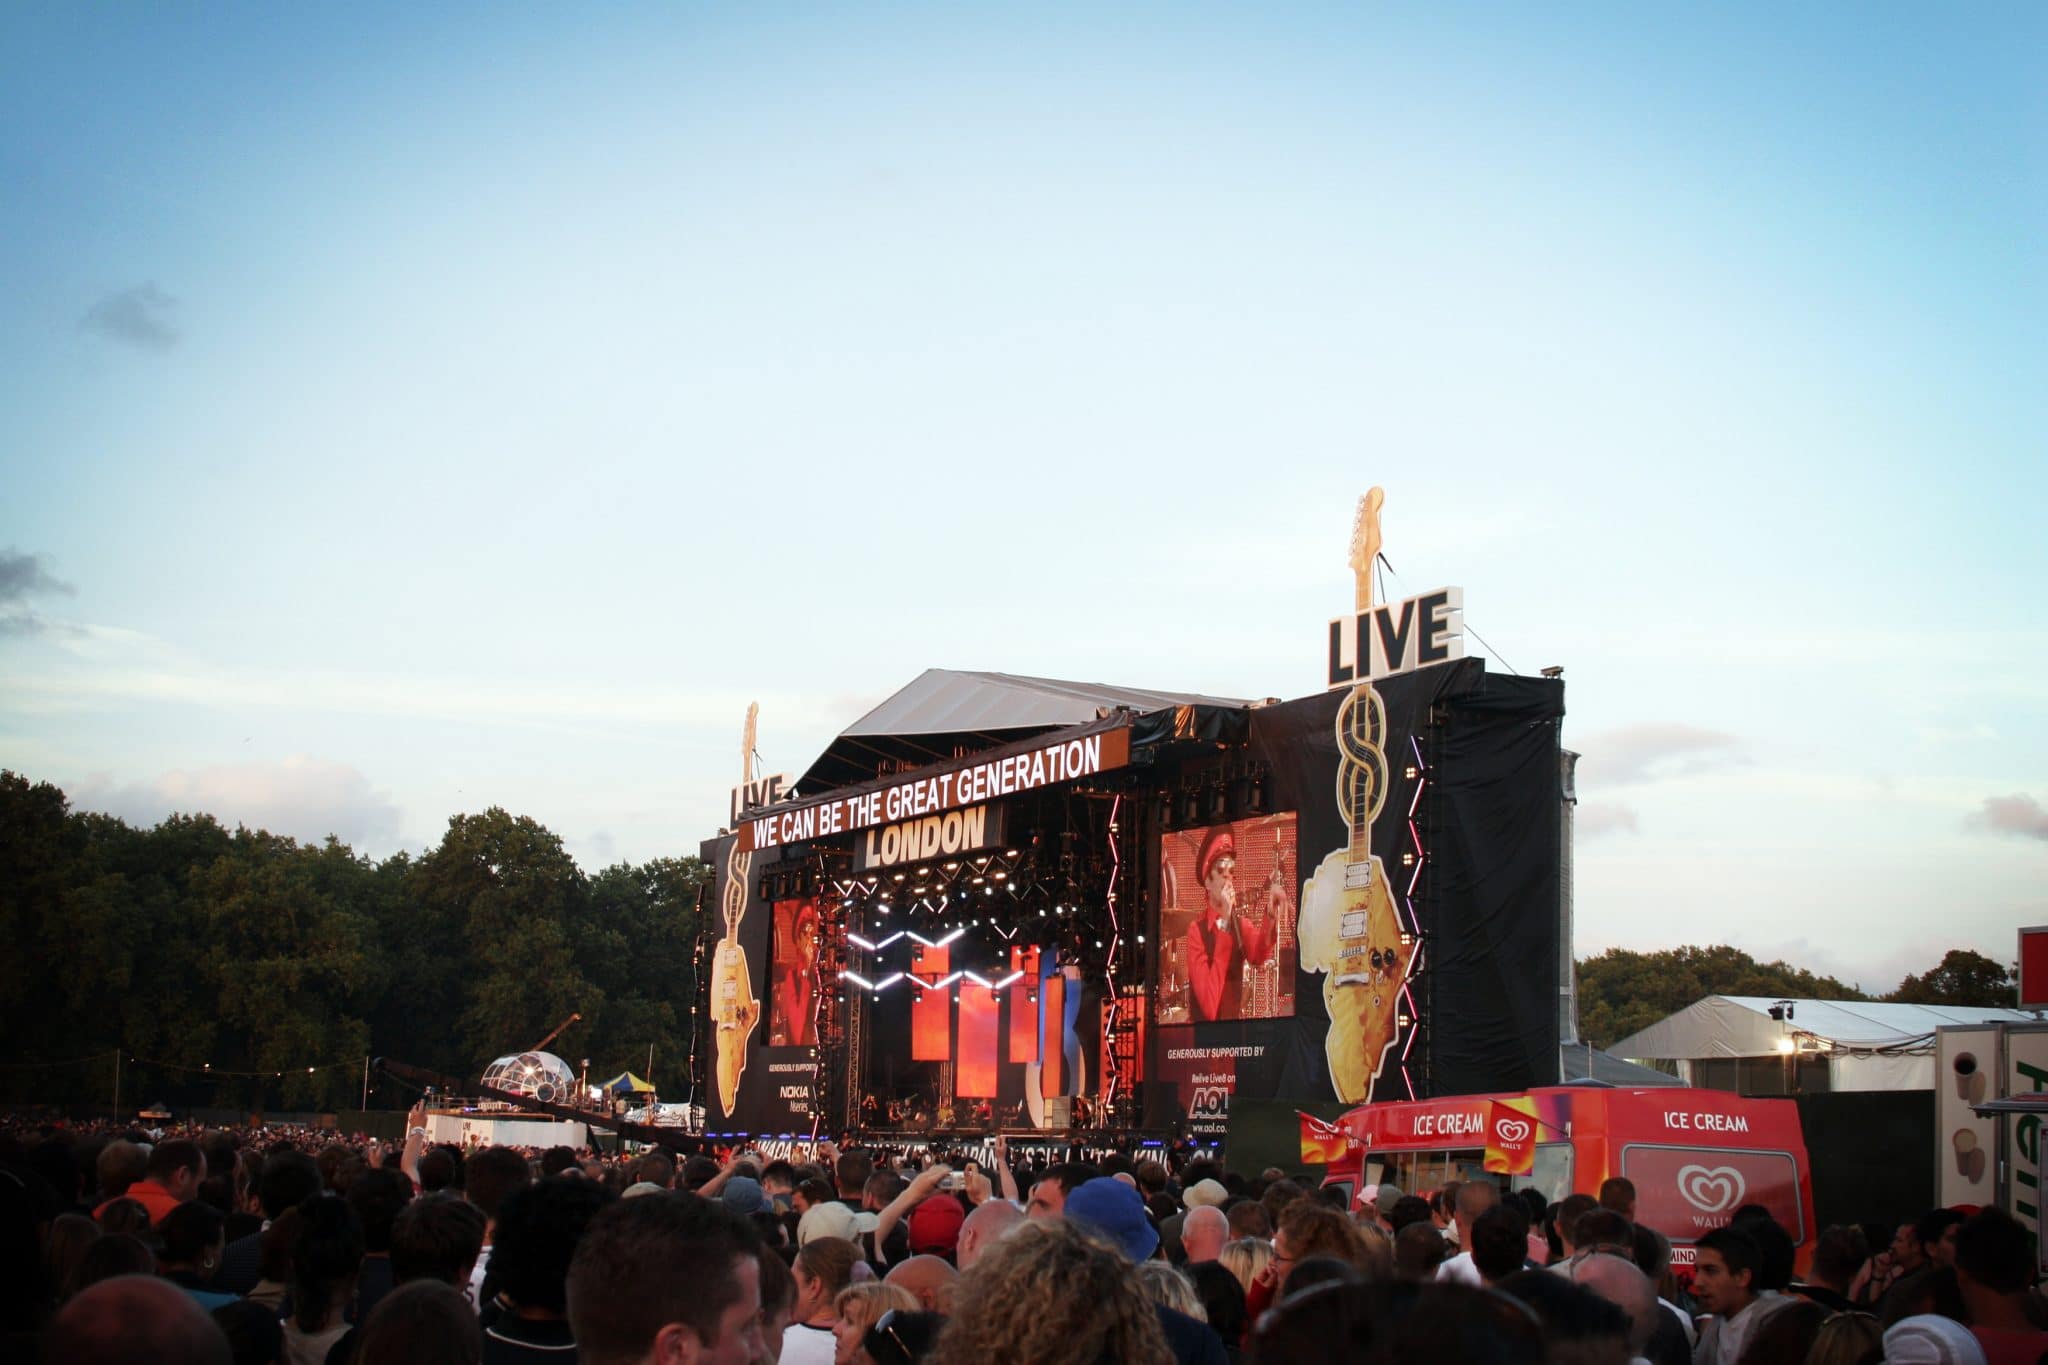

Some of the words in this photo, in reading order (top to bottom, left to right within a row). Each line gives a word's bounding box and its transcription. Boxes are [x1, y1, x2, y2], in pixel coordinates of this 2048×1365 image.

[1329, 590, 1449, 686] LIVE
[730, 775, 783, 831] LIVE
[753, 816, 778, 849] WE
[781, 807, 815, 843] CAN
[819, 800, 842, 836] BE
[848, 791, 882, 829] THE
[886, 773, 953, 821] GREAT
[957, 735, 1101, 804] GENERATION
[865, 805, 986, 869] LONDON
[1167, 1049, 1211, 1060] GENEROUSLY
[1211, 1046, 1253, 1058] SUPPORTED
[1254, 1046, 1264, 1057] BY
[780, 1086, 809, 1098] NOKIA
[1187, 1086, 1229, 1119] AOL
[1413, 1115, 1434, 1136] ICE
[1437, 1113, 1483, 1134] CREAM
[1664, 1111, 1690, 1129] ICE
[1694, 1113, 1749, 1132] CREAM
[1692, 1215, 1732, 1229] WALL'
